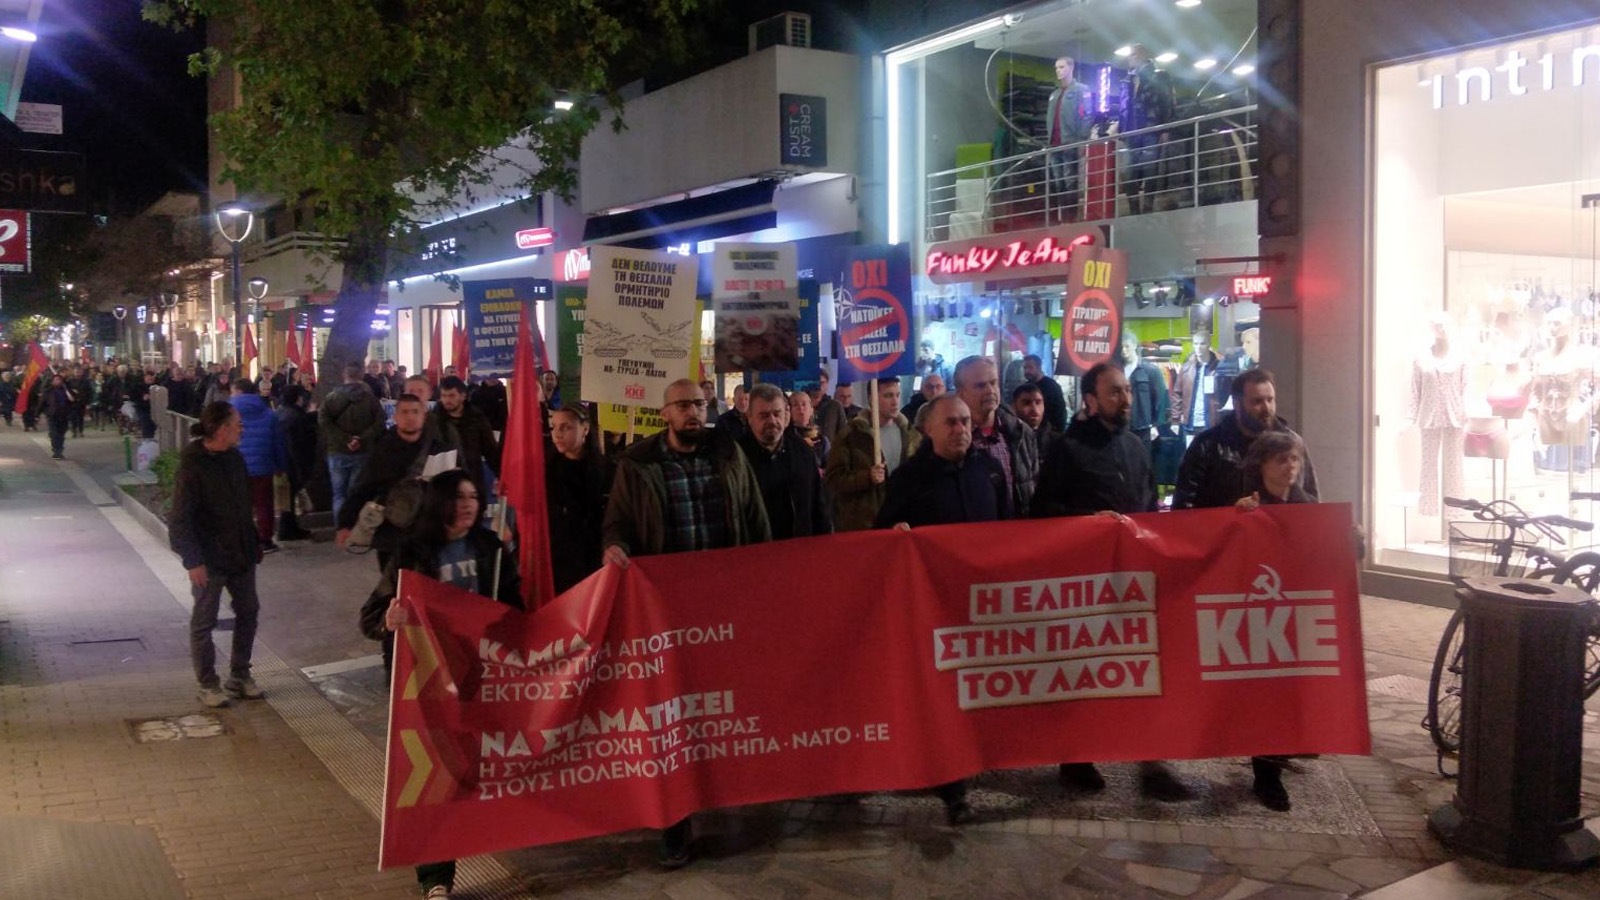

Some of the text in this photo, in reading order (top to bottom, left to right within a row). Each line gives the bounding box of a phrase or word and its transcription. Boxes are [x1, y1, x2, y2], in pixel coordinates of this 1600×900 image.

[789, 117, 800, 157] DUST
[800, 104, 811, 158] CREAM
[612, 258, 677, 275] ΔΕΝ ΘΕΛΟΥΜΕ
[614, 271, 672, 286] ΤΗ ΘΕΣΣΑΛΙΑ
[852, 260, 888, 289] ΟΧΙ
[1083, 260, 1112, 289] ΟΧΙ
[614, 283, 670, 298] ΟΡΜΗΤΗΡΙΟ
[618, 295, 664, 310] ΠΟΛΕΜΩΝ
[618, 359, 655, 369] ΥΠΕΥΘΥΝΟΙ
[844, 340, 906, 359] ΣΤΗ ΘΕΣΣΑΛΙΑ
[624, 386, 646, 399] ΚΚΕ
[977, 576, 1148, 615] Η ΕΛΠΙΔΑ
[479, 633, 592, 668] ΚΑΜΙΑ
[618, 623, 734, 658] ΑΠΟΣΤΟΛΗ
[939, 617, 1149, 662] ΣΤΗΝ ΠΑΛΗ
[1196, 604, 1340, 667] ΚΚΕ
[481, 681, 555, 703] ΕΚΤΟΣ
[963, 660, 1150, 700] ΤΟΥ ΛΑΟΥ
[481, 689, 735, 758] ΝΑ ΣΤΑΜΑΤΗΣΕΙ
[479, 716, 762, 779] Η ΣΥΜΜΕΤΟΧΗ ΤΗΣ ΧΩΡΑΣ
[479, 722, 891, 800] ΣΤΟΥΣ ΠΟΛΕΜΟΥΣ ΤΩΝ ΗΠΑ ΝΑΤΟ ΕΕ
